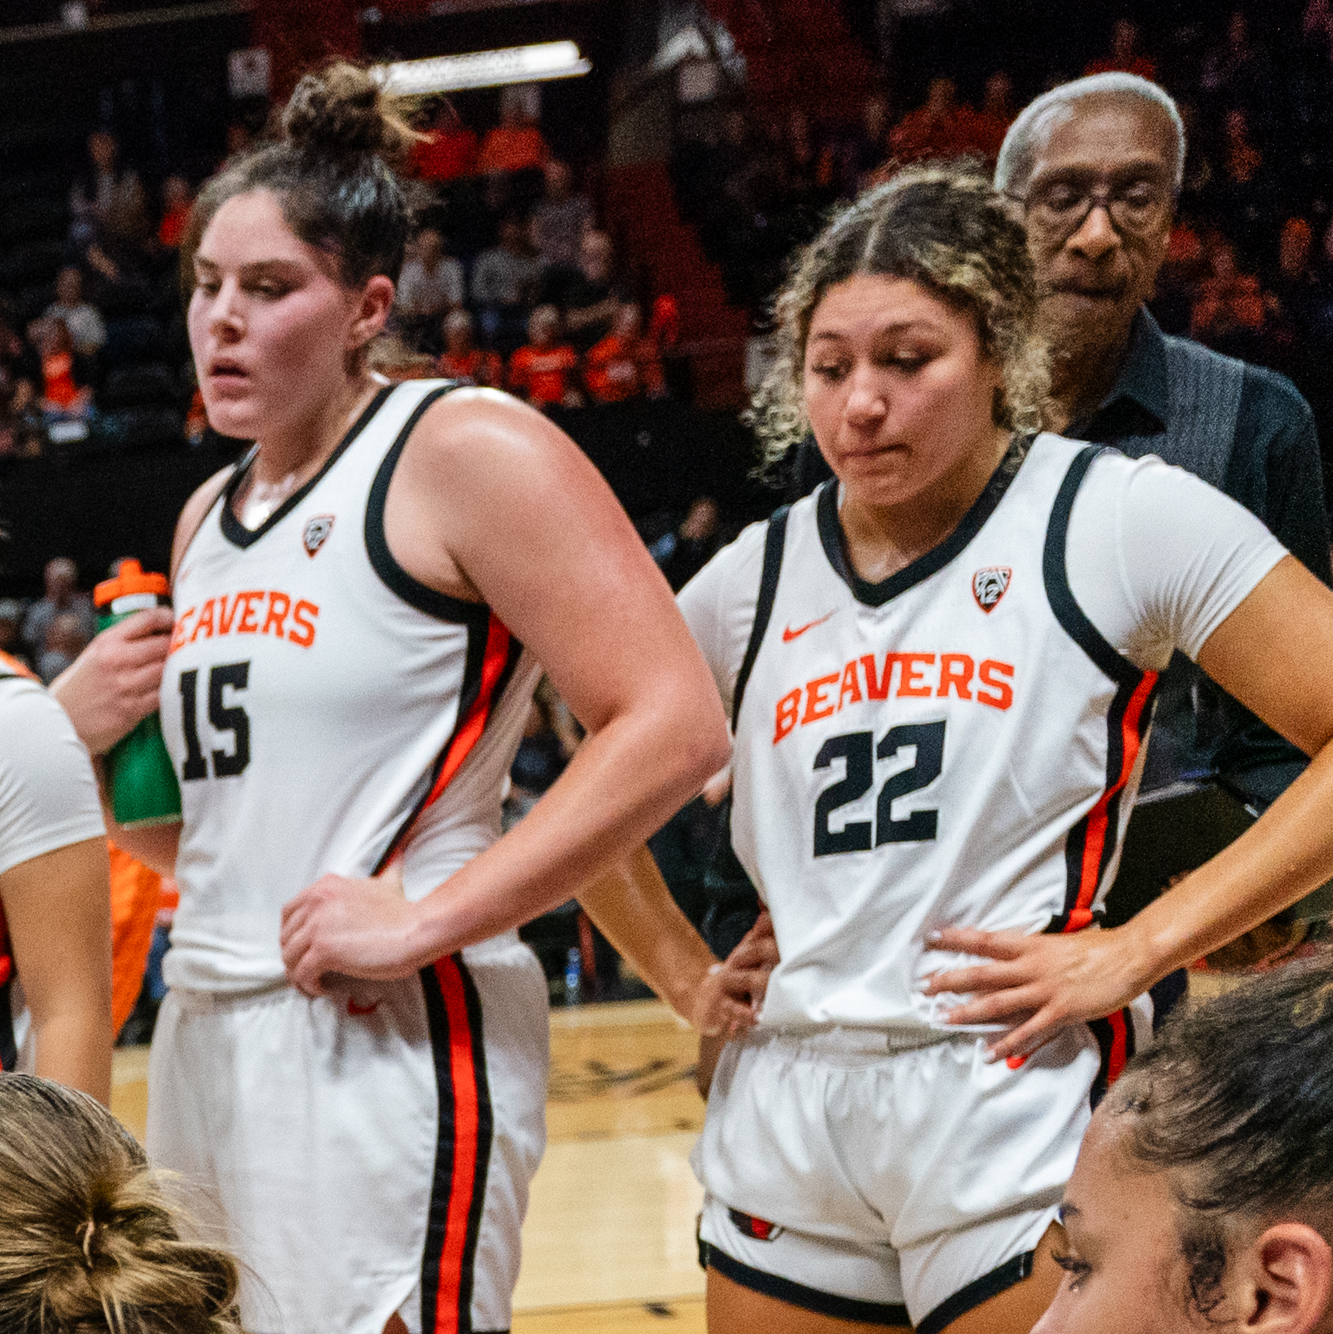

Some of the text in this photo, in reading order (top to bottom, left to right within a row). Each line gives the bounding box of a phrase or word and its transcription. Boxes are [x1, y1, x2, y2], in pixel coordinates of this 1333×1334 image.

[179, 660, 252, 782] 15
[773, 652, 1015, 746] BEAVERS
[813, 719, 947, 858] 22
